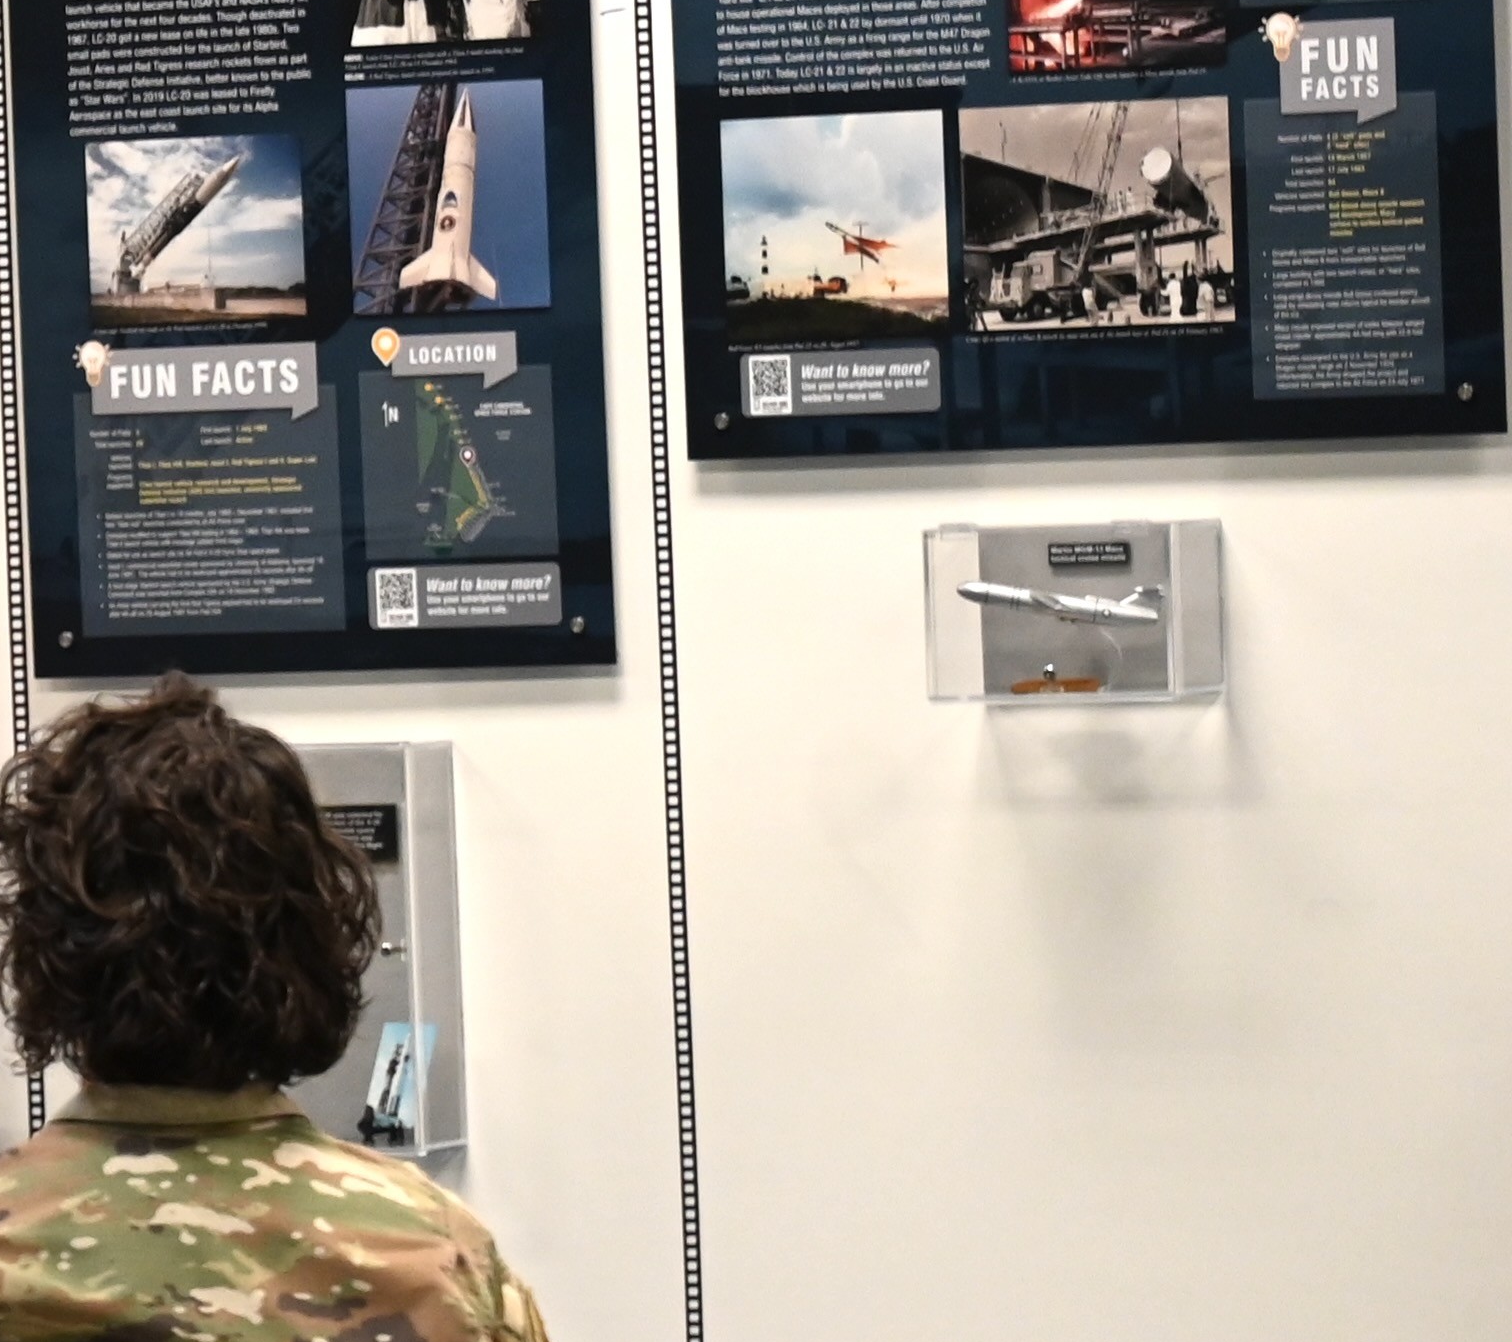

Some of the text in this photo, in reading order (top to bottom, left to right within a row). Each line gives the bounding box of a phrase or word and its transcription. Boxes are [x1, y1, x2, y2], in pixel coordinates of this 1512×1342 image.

[1300, 35, 1379, 75] FUN
[1300, 75, 1380, 101] FACTS
[409, 344, 497, 365] LOCATION
[110, 356, 300, 399] FUN FACTS
[801, 359, 931, 380] Want to know more?
[389, 407, 400, 423] N
[426, 574, 552, 593] Want to know more?
